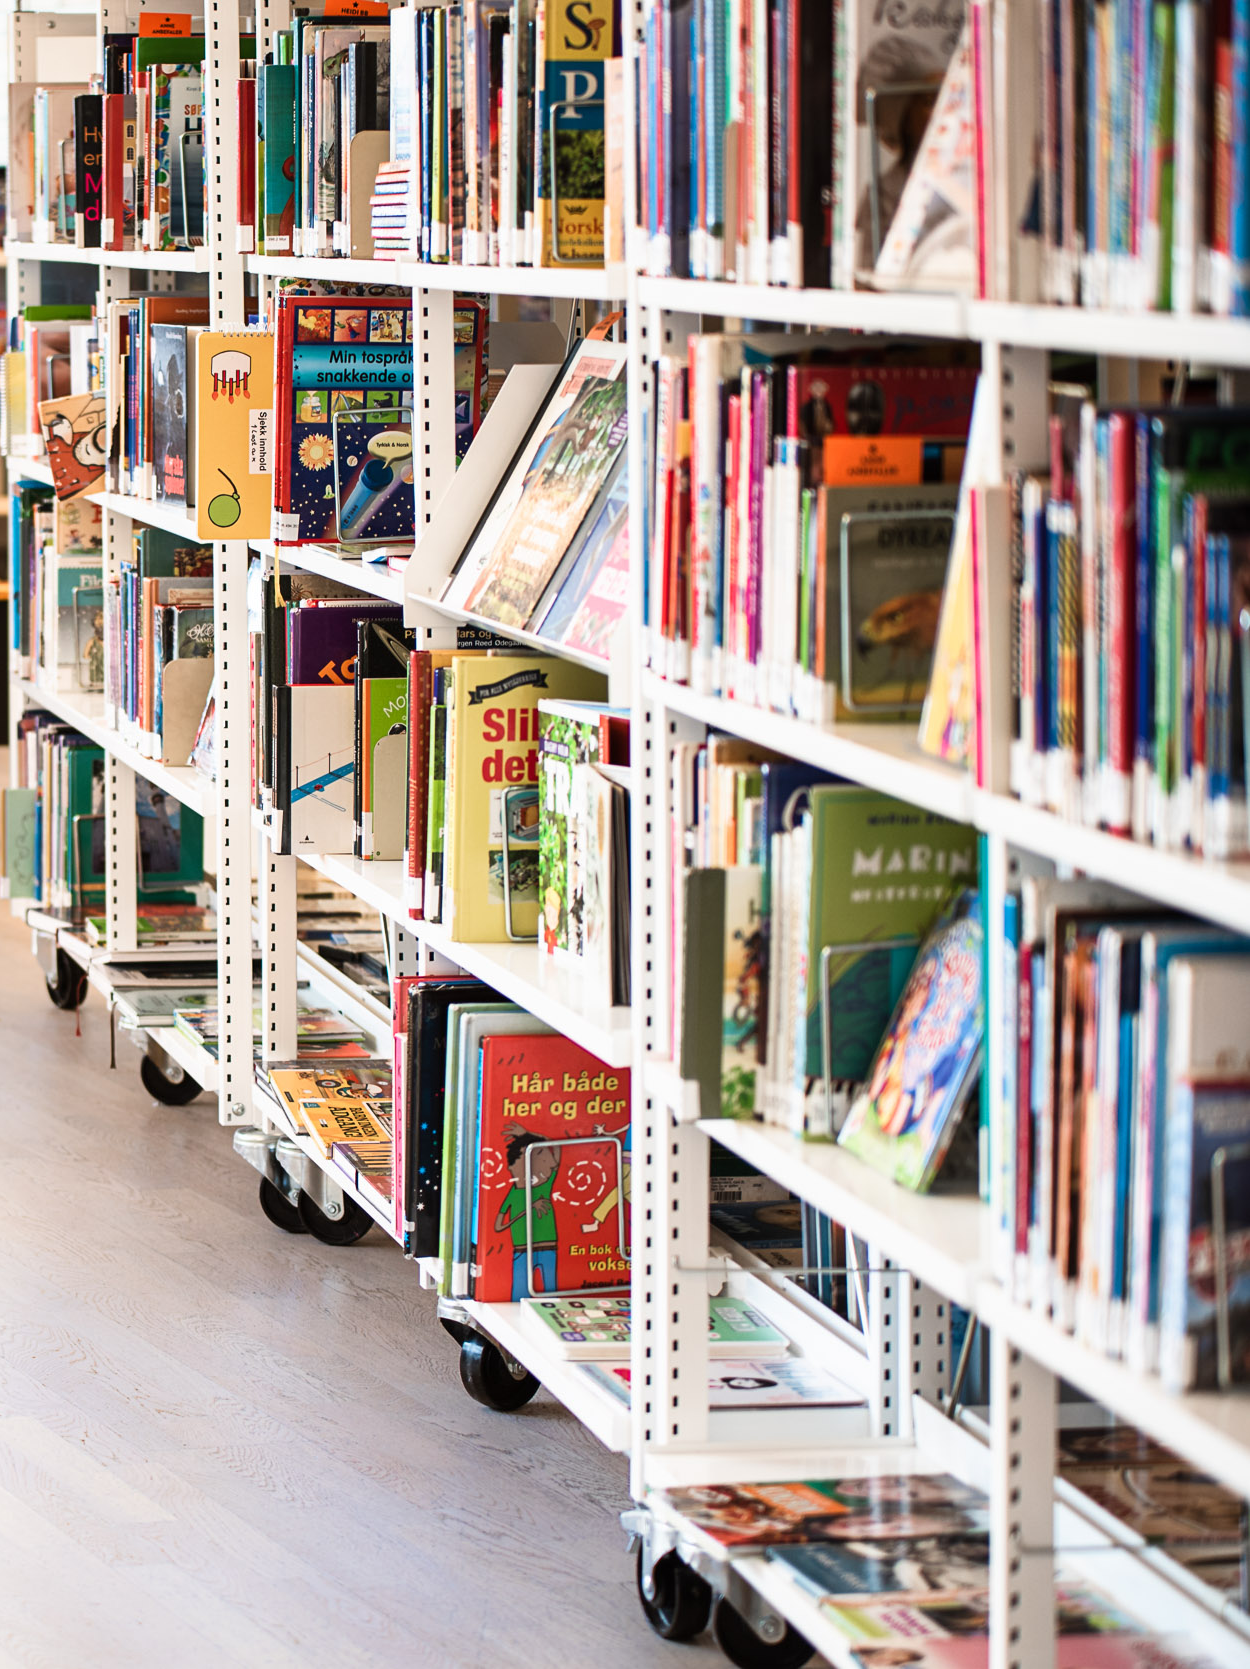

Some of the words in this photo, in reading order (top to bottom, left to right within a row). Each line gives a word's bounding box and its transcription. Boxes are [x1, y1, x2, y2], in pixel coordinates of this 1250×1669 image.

[329, 350, 357, 364] Min
[316, 368, 397, 383] snakkende
[258, 411, 268, 436] Sjekk
[259, 438, 268, 471] innhold
[478, 631, 492, 641] og
[482, 749, 539, 783] det
[511, 1071, 555, 1093] Hår
[562, 1070, 619, 1092] både
[502, 1098, 542, 1117] her
[549, 1100, 578, 1120] og
[586, 1095, 627, 1115] der
[570, 1245, 586, 1256] En
[589, 1244, 612, 1255] bok
[588, 1257, 632, 1271] vokse
